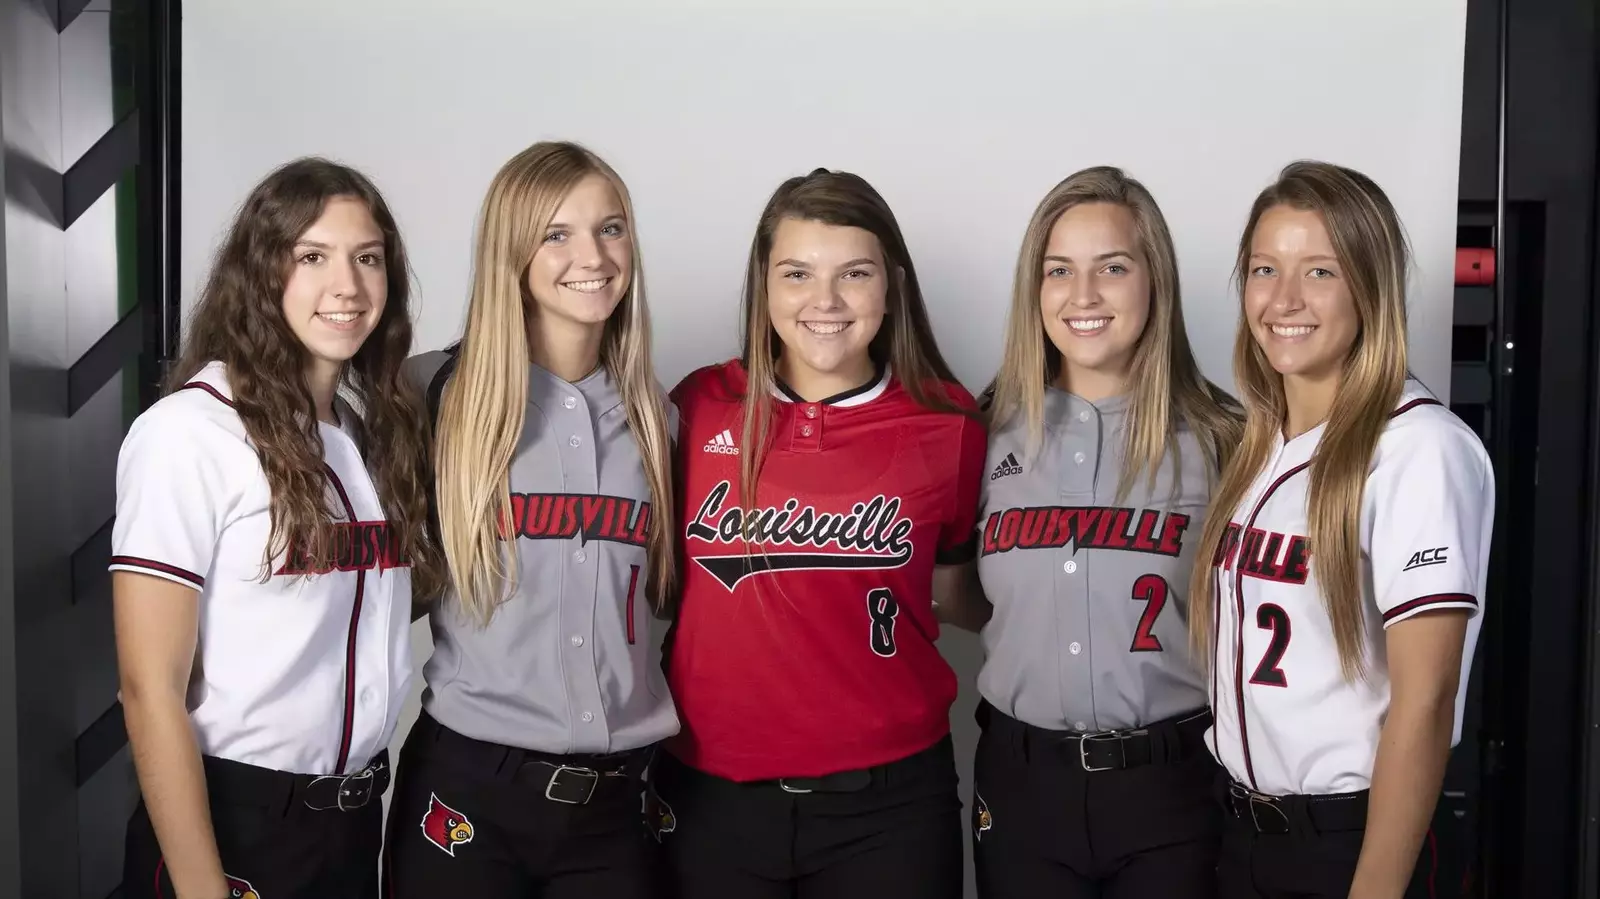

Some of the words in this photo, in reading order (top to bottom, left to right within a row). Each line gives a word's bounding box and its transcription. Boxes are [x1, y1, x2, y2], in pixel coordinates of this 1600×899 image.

[703, 443, 739, 455] adidas
[990, 465, 1023, 480] adidas
[686, 480, 913, 554] Louisville
[981, 506, 1190, 557] LOUISVILLE
[1405, 547, 1449, 567] ACC
[867, 587, 899, 657] 8
[1130, 574, 1168, 652] 2
[1249, 603, 1292, 687] 2
